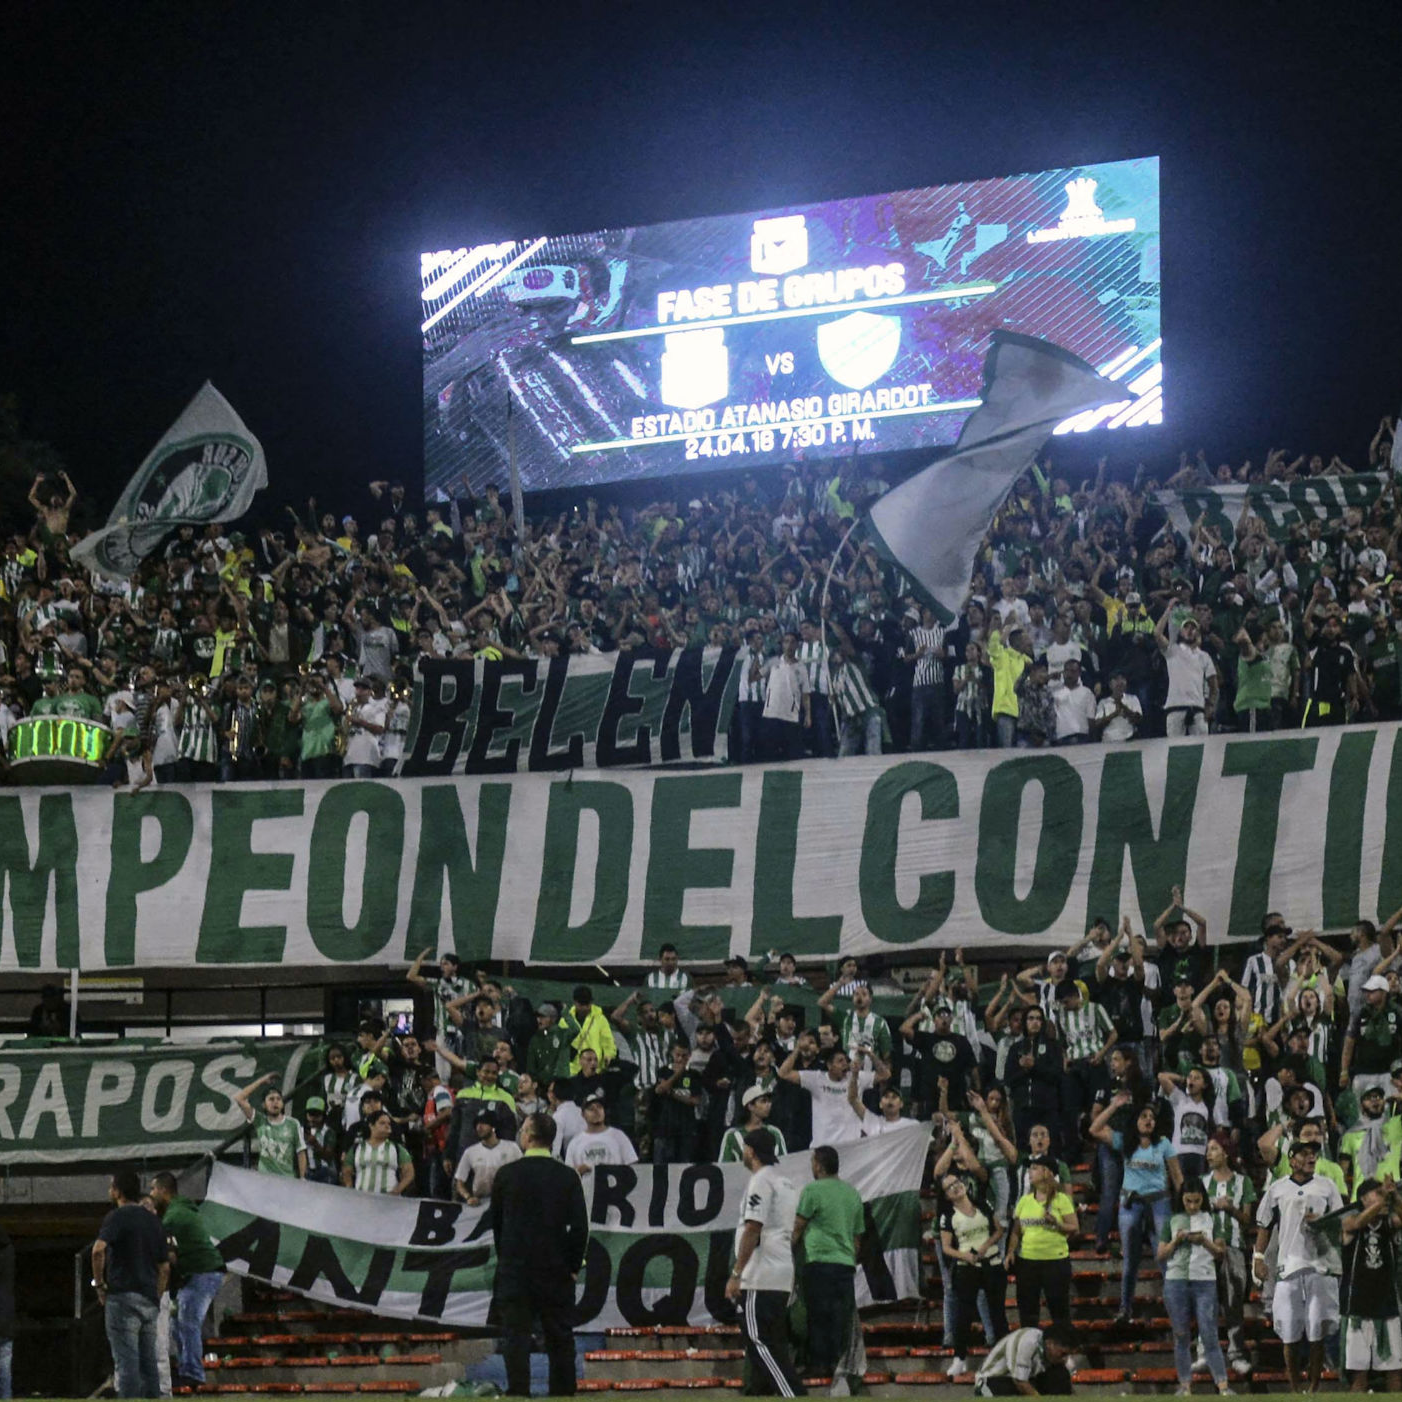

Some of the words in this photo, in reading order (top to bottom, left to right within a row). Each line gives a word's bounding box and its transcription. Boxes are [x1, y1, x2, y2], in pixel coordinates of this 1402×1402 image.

[657, 284, 732, 323] FASE
[737, 278, 779, 314] DE
[783, 262, 906, 308] GRUPOS
[764, 351, 795, 376] VS
[631, 409, 716, 439] ESTADIO
[720, 395, 823, 427] ATANASIO
[827, 383, 933, 416] GIRARDOT
[780, 423, 827, 449] 7:30
[402, 647, 743, 775] BELEN
[530, 770, 844, 962] DEL
[411, 1163, 725, 1246] BRIO
